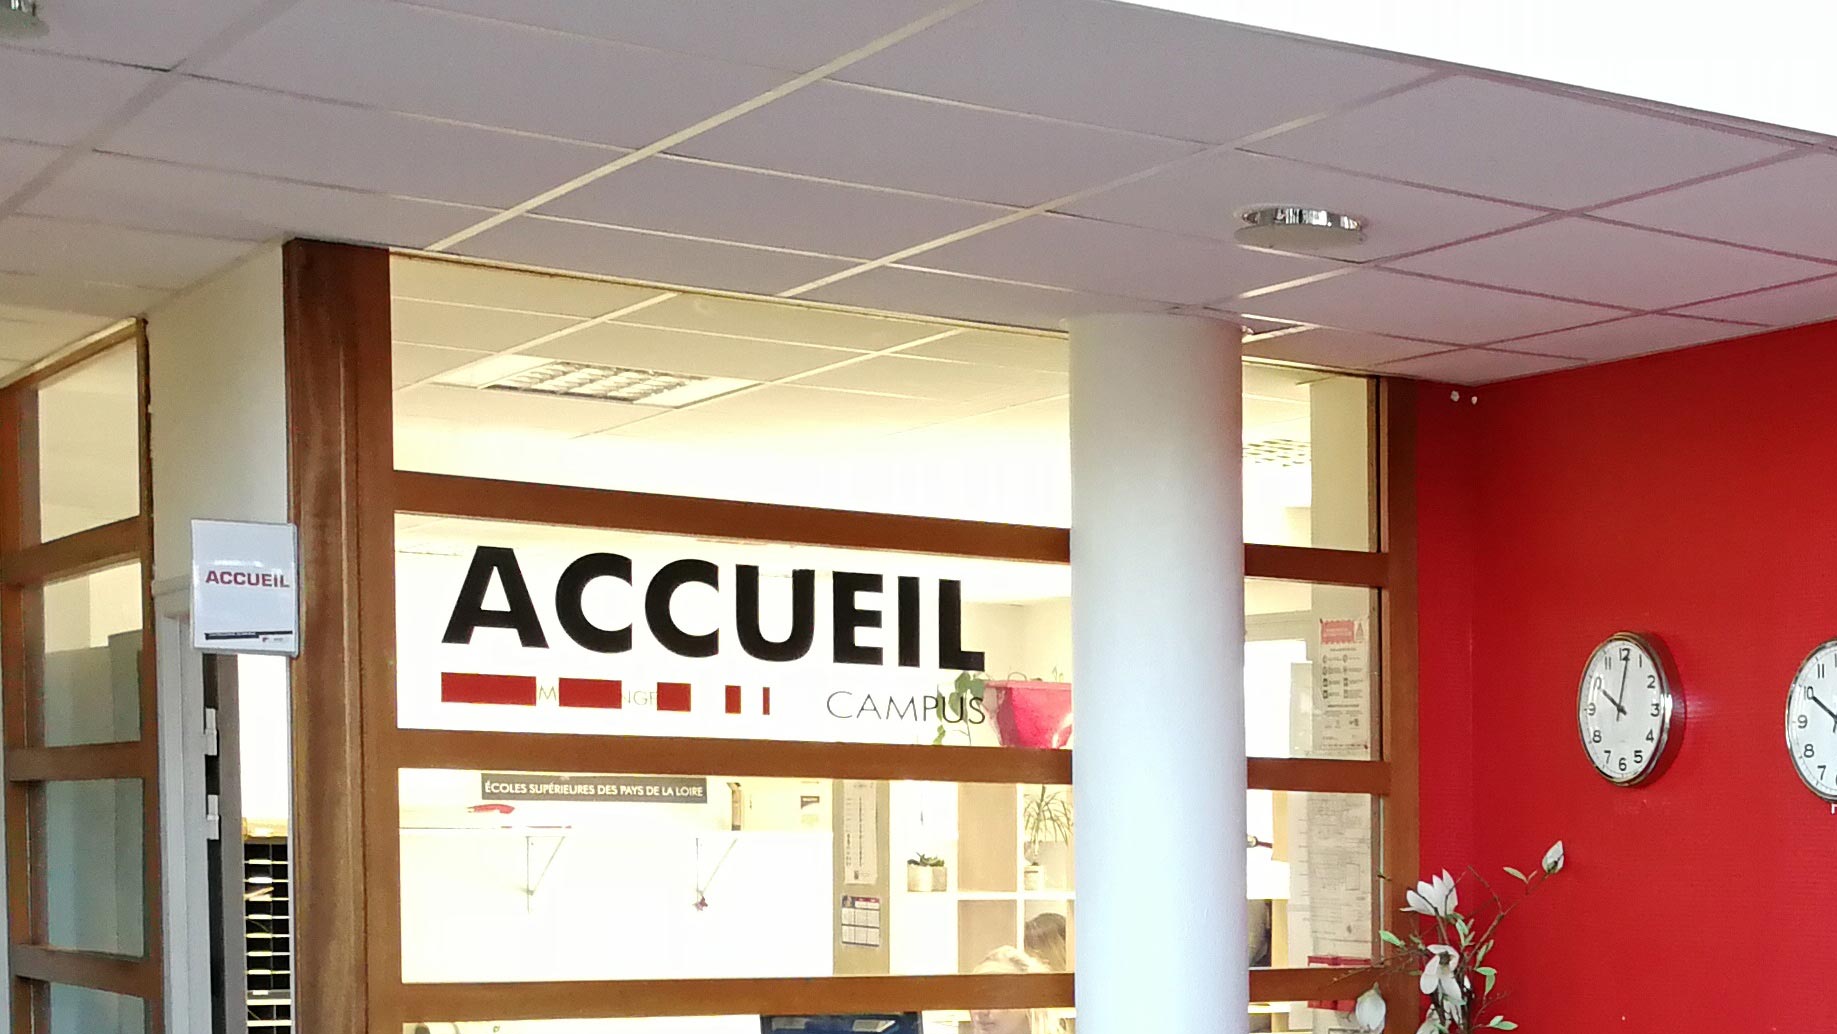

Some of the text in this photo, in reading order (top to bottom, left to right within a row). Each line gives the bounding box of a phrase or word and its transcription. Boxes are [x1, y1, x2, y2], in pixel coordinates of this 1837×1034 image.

[205, 570, 290, 588] ACCUEIL
[441, 545, 985, 672] ACCUEIL
[1605, 656, 1611, 670] 11
[1817, 664, 1825, 678] 11
[1647, 675, 1656, 689] 2
[1804, 686, 1814, 700] 10
[827, 690, 986, 724] CAMPUS
[1588, 703, 1596, 716] 9
[1650, 704, 1660, 717] 3
[1797, 715, 1808, 729] 9
[1592, 730, 1602, 743] 8
[1646, 729, 1654, 742] 4
[1604, 750, 1611, 764] 7
[1634, 750, 1643, 764] 5
[1804, 744, 1814, 758] 8
[1619, 758, 1627, 771] 6
[1817, 765, 1827, 780] 7
[485, 779, 703, 797] ÉCOLES SUPÉRIEURES DES PAYS DE LA LOIRE
